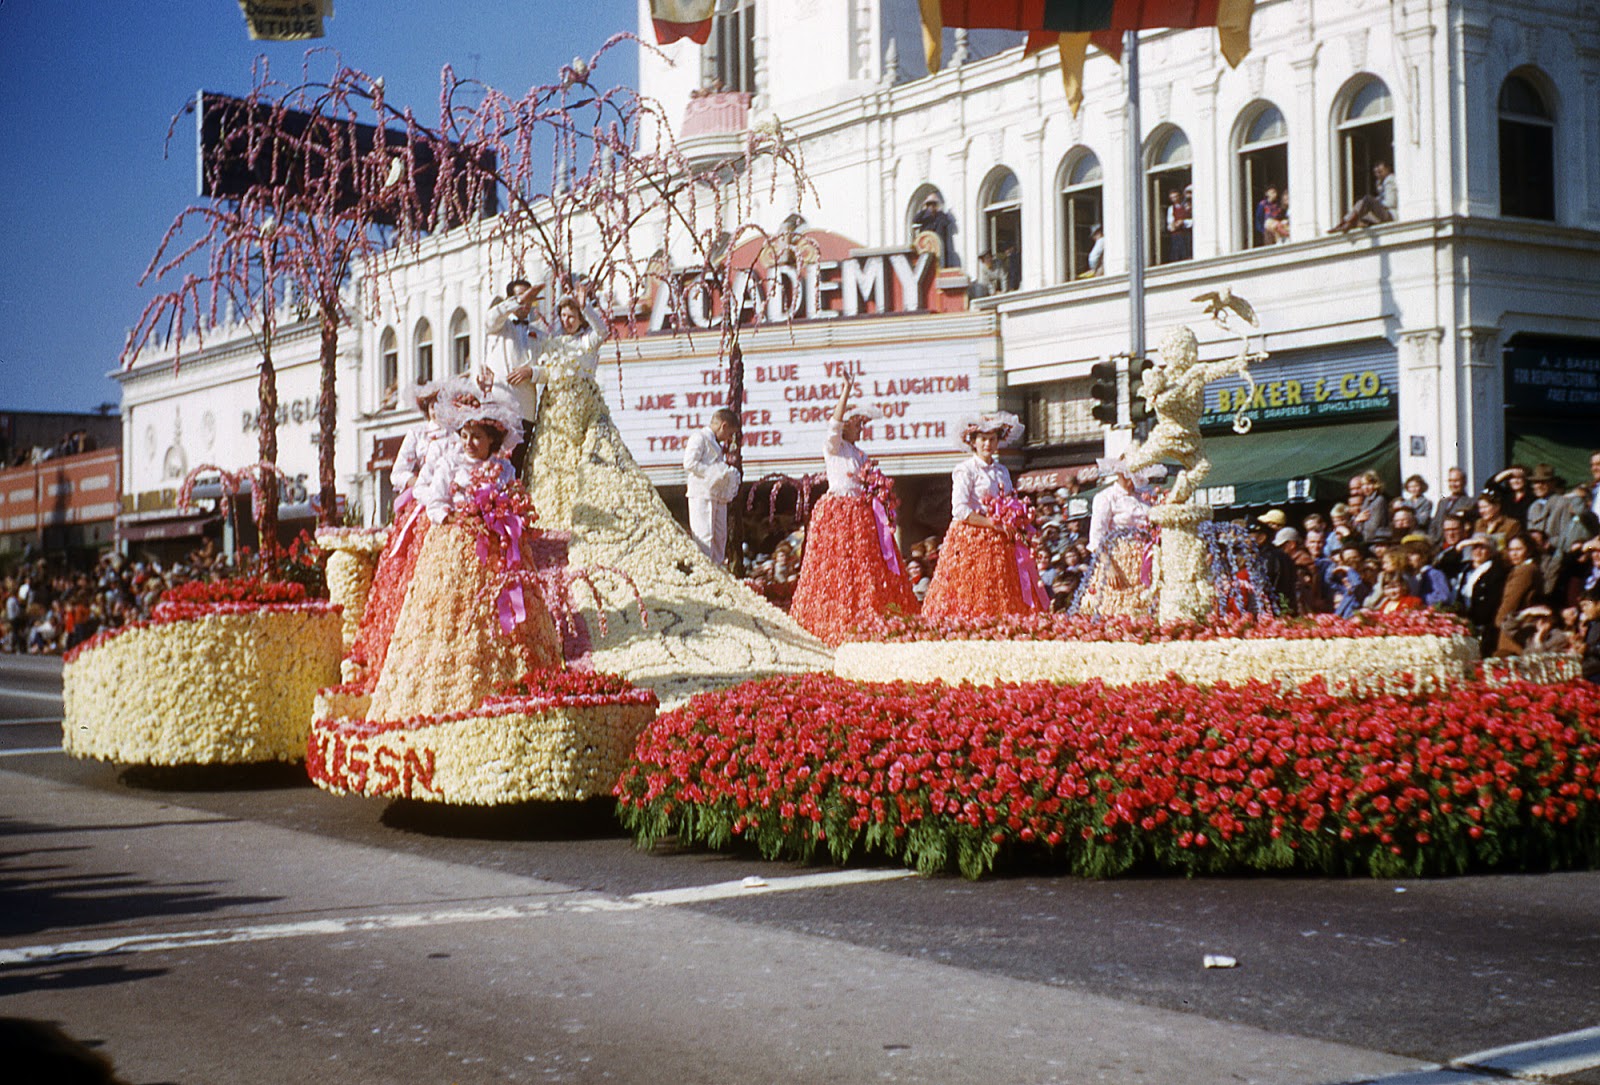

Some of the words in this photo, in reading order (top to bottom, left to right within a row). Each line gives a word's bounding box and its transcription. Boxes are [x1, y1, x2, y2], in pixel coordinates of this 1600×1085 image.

[648, 252, 937, 333] ACADEMY
[756, 364, 799, 382] BLUE
[824, 360, 866, 377] VEIL
[635, 394, 676, 411] JANE
[874, 374, 970, 397] LAUGHTON
[1217, 383, 1303, 412] BAKER
[1315, 378, 1334, 401] &
[1340, 371, 1389, 398] CO.
[1318, 396, 1390, 413] UPHOLSTERING
[789, 404, 856, 424] FORG
[647, 436, 688, 452] TYRO
[885, 421, 945, 440] BLYTH
